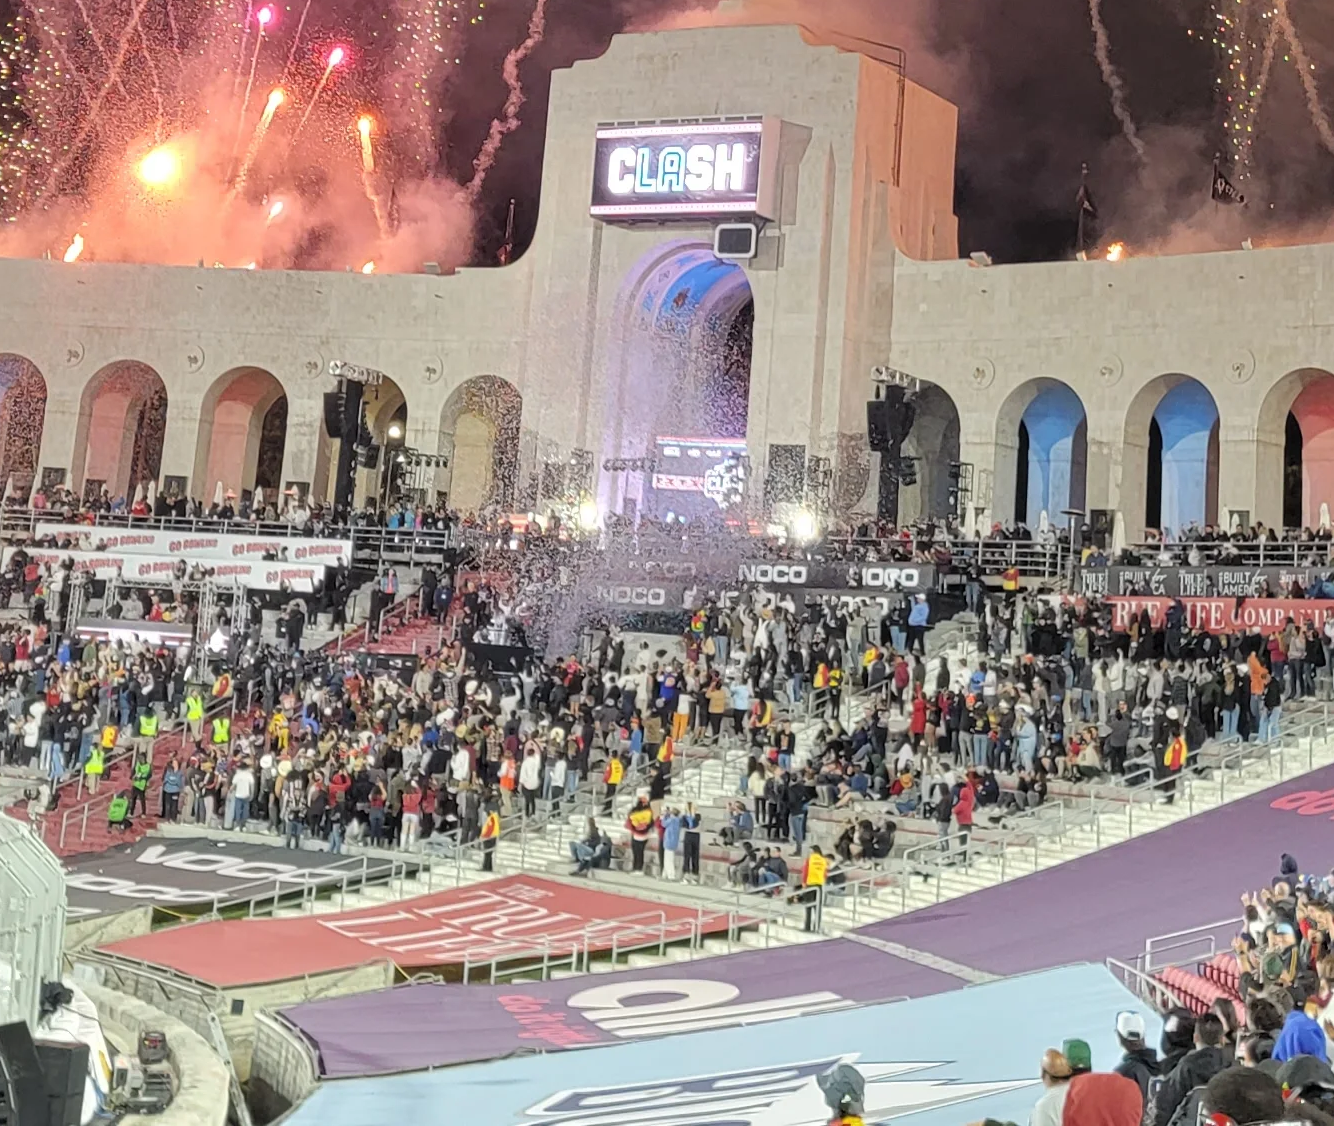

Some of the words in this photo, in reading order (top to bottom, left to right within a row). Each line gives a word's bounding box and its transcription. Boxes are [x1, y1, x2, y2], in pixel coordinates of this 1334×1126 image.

[608, 143, 744, 194] CLASH
[739, 565, 807, 584] NOCO
[1223, 572, 1250, 583] BUILT
[1222, 583, 1260, 596] AMERIC
[1113, 601, 1161, 628] RUE
[1186, 602, 1225, 629] IFE
